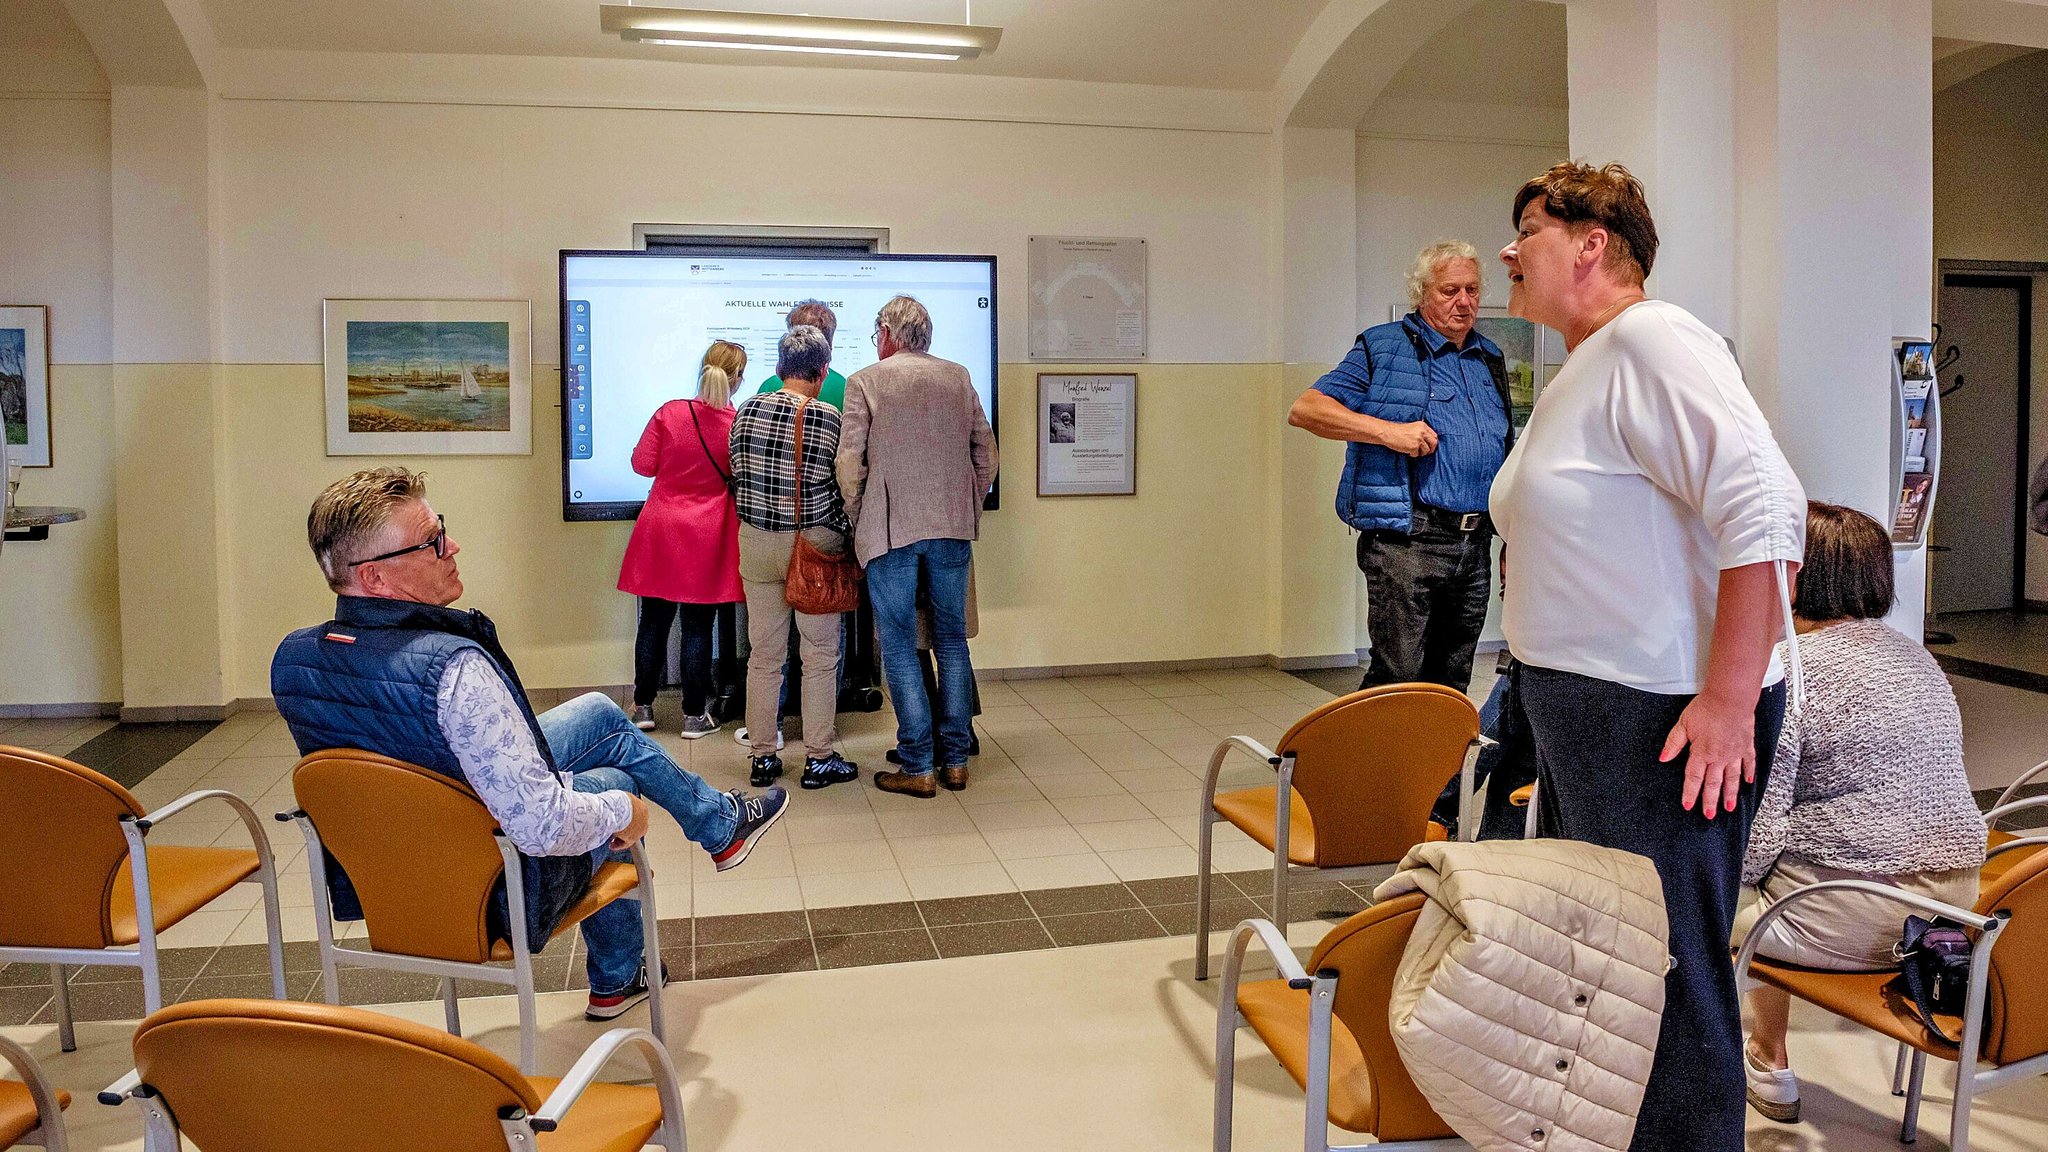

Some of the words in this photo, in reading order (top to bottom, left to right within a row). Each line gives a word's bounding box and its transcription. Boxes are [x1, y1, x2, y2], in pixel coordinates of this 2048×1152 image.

[725, 300, 767, 308] AKTUELLE
[768, 300, 844, 308] WAHLEISSE
[745, 798, 763, 822] N
